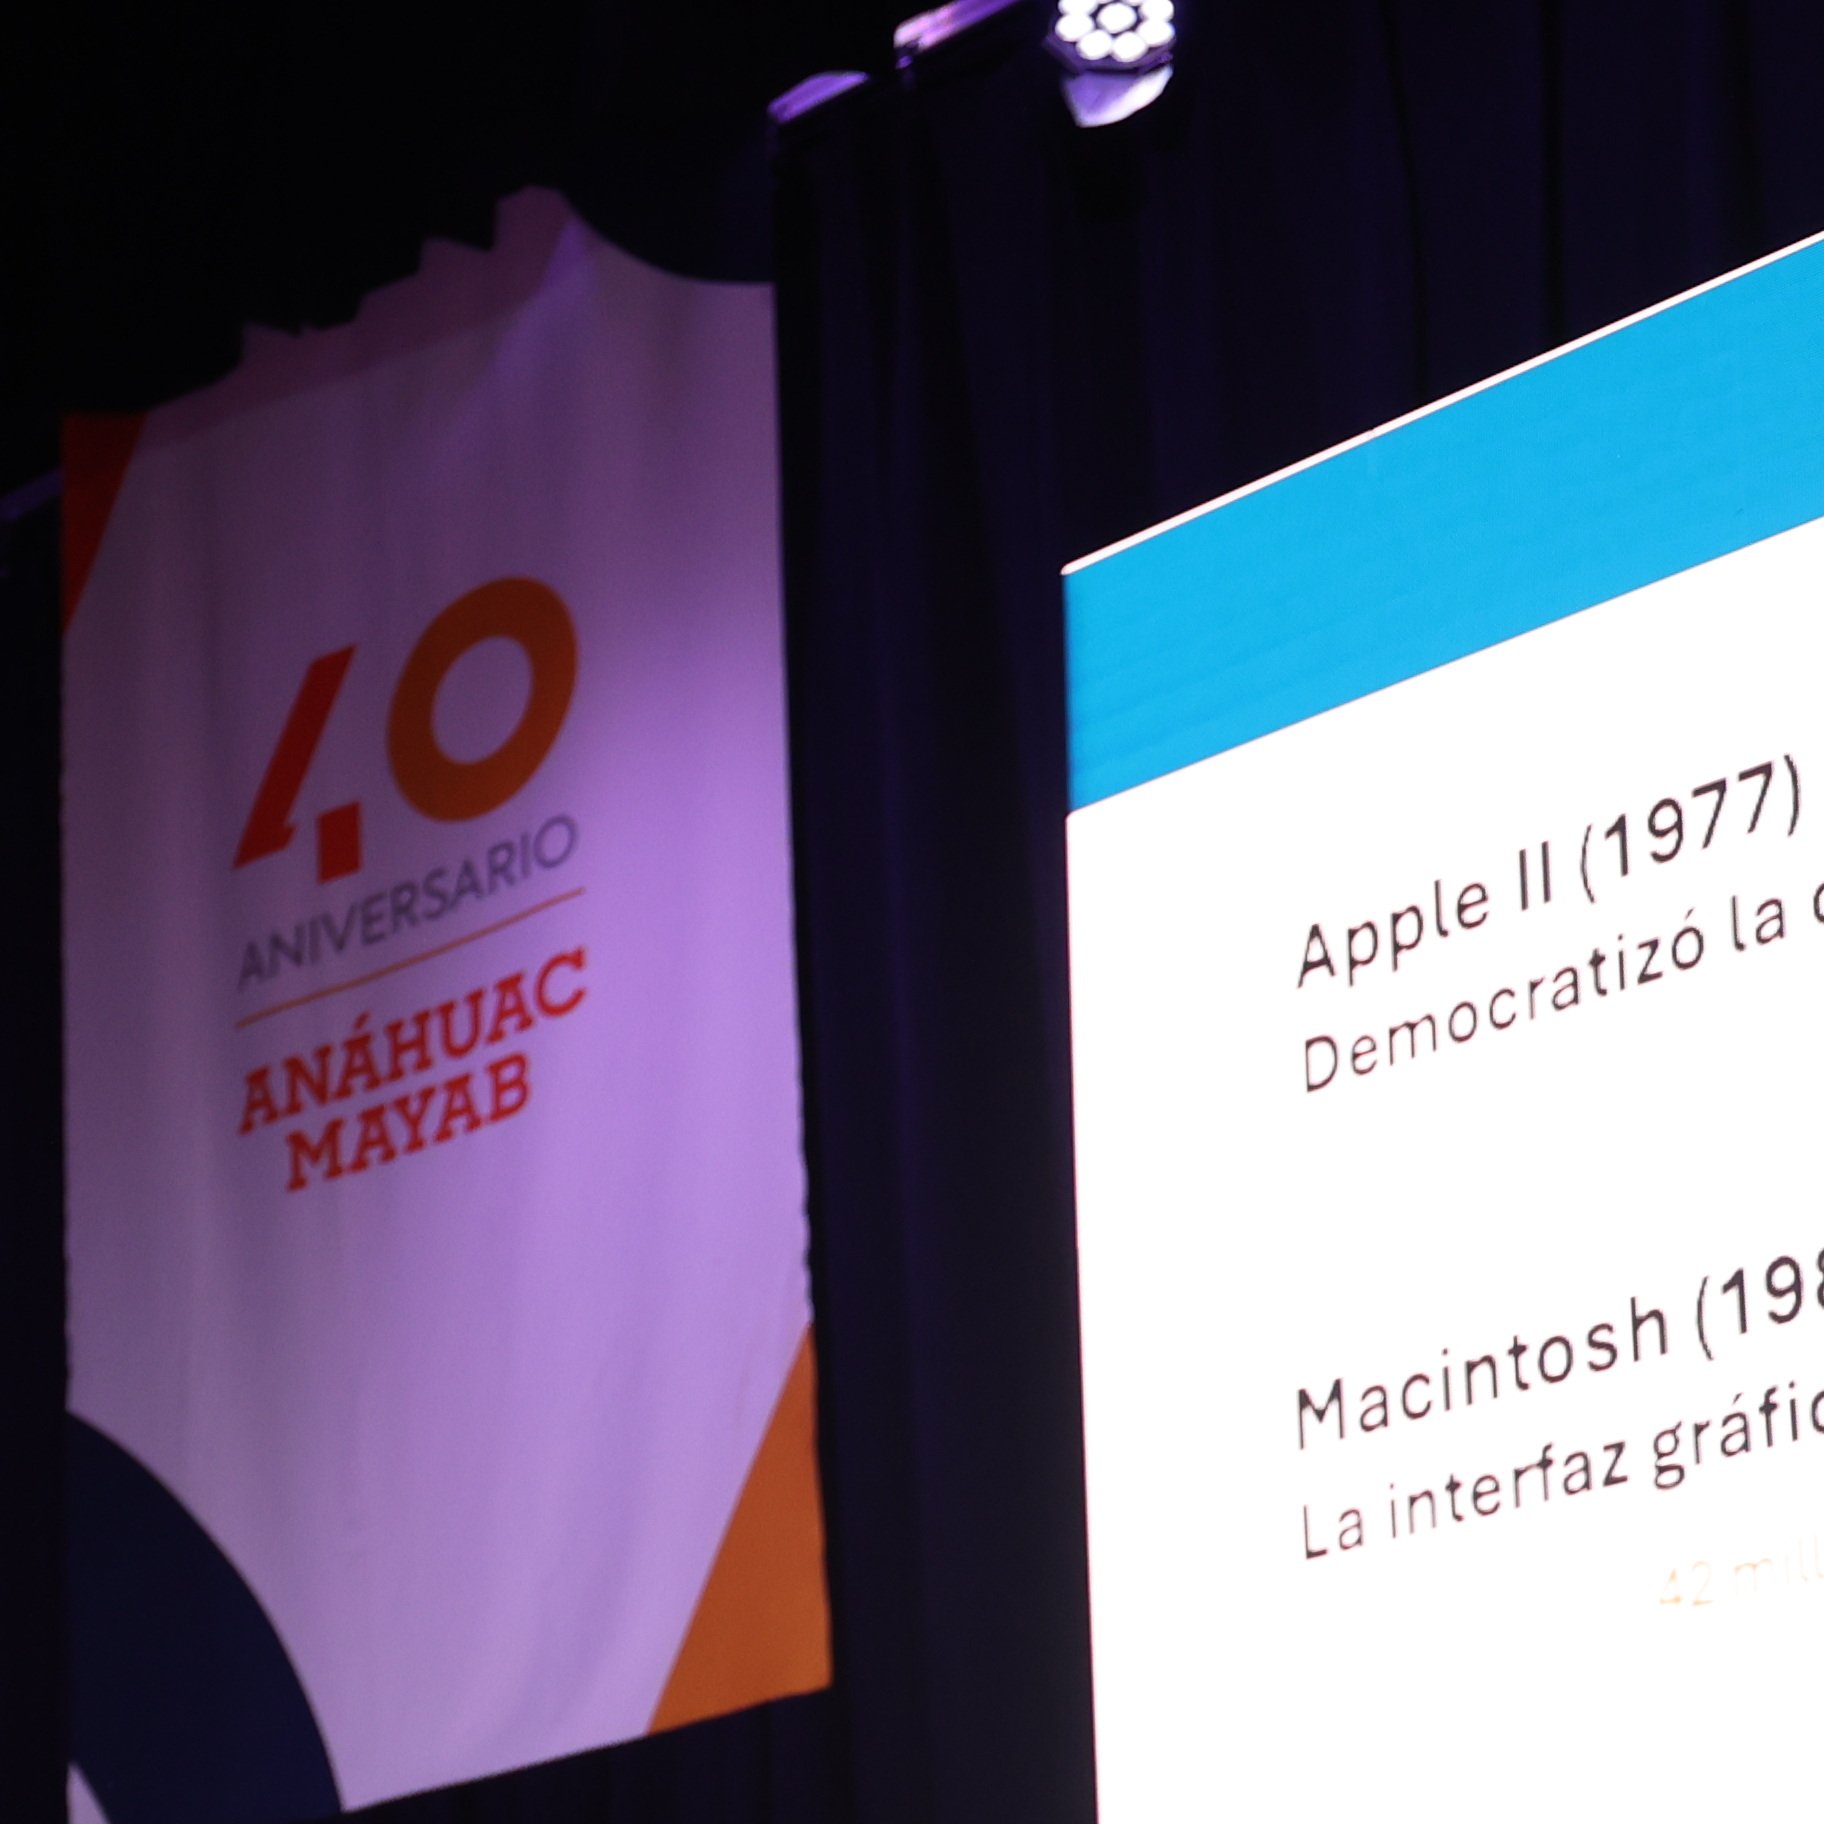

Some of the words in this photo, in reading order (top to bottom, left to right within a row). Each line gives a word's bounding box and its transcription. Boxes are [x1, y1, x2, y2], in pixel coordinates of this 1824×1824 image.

[232, 575, 581, 885] 40
[237, 813, 580, 991] ANIVERSARIO
[1297, 879, 1489, 989] Apple
[1579, 754, 1801, 904] (1977)
[239, 946, 588, 1136] ANÁHUAC
[1304, 907, 1705, 1093] Democratizó
[1731, 895, 1786, 953] la
[285, 1052, 532, 1193] MAYAB
[1297, 1296, 1668, 1450] Macintosh
[1696, 1247, 1824, 1361] (19
[1303, 1506, 1364, 1560] La
[1390, 1441, 1629, 1539] interfaz
